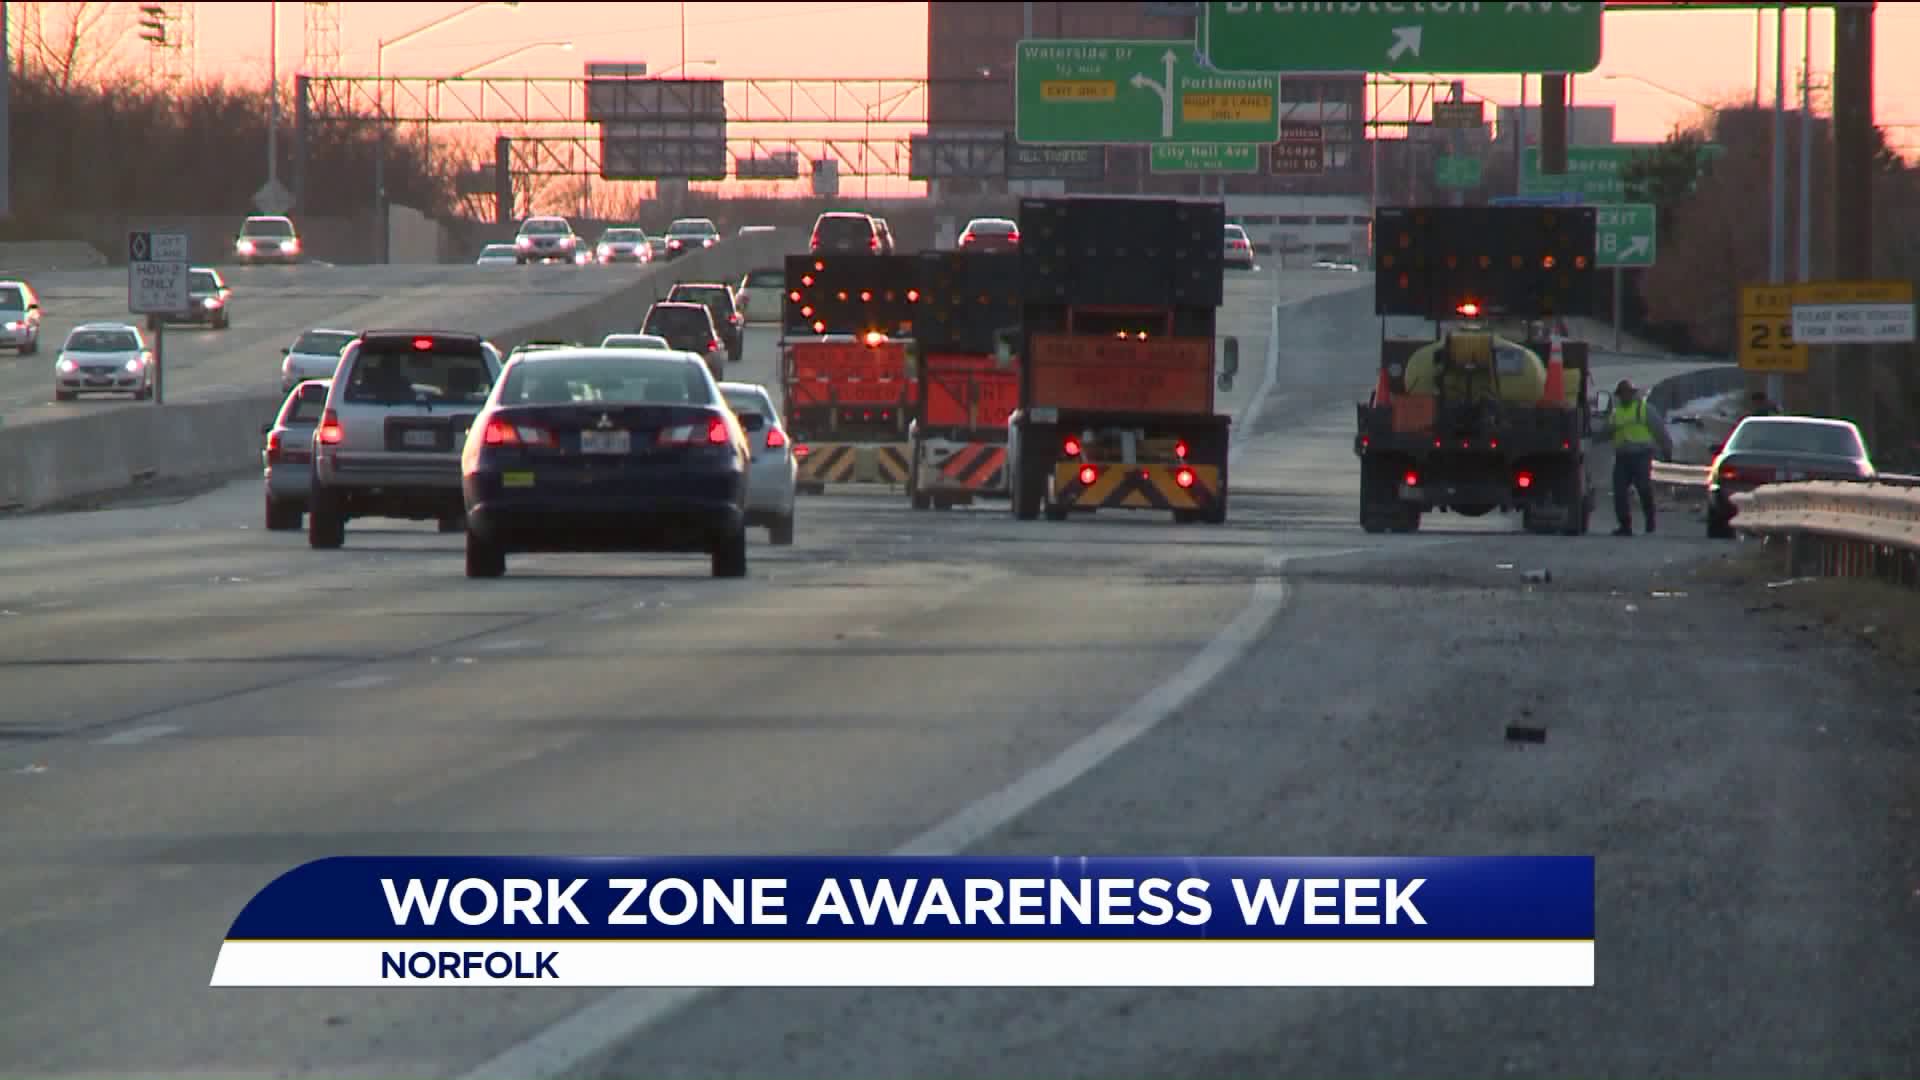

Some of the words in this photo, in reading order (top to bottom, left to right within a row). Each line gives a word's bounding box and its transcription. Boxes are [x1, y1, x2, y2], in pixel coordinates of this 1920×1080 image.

[1024, 47, 1108, 59] Waterside
[1115, 47, 1132, 59] Dr
[1181, 76, 1273, 90] Portsmouth
[1158, 144, 1184, 160] City
[1191, 144, 1217, 157] Hall
[1225, 144, 1249, 157] Ave
[1597, 208, 1638, 225] EXIT
[136, 263, 179, 275] HOV-2
[141, 278, 174, 289] ONLY
[1751, 324, 1795, 350] 25
